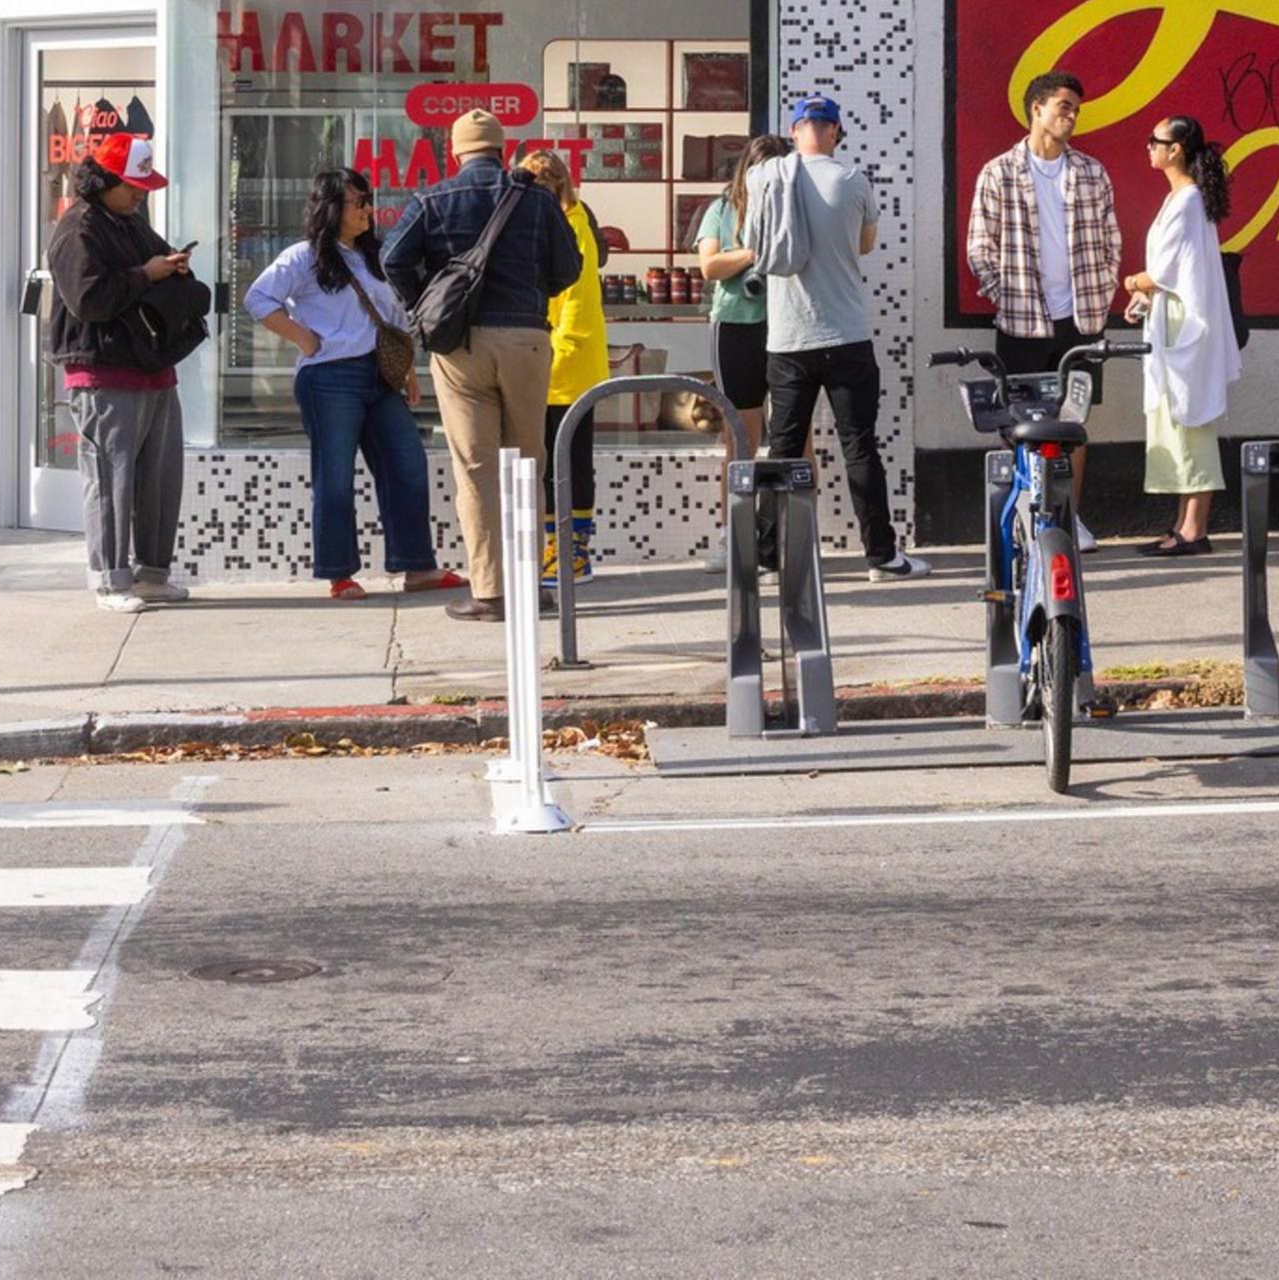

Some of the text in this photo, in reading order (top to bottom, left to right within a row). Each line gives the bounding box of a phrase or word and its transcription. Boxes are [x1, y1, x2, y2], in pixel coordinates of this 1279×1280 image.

[216, 11, 503, 73] MARKET
[423, 96, 520, 115] CORNER
[353, 138, 593, 188] MAT
